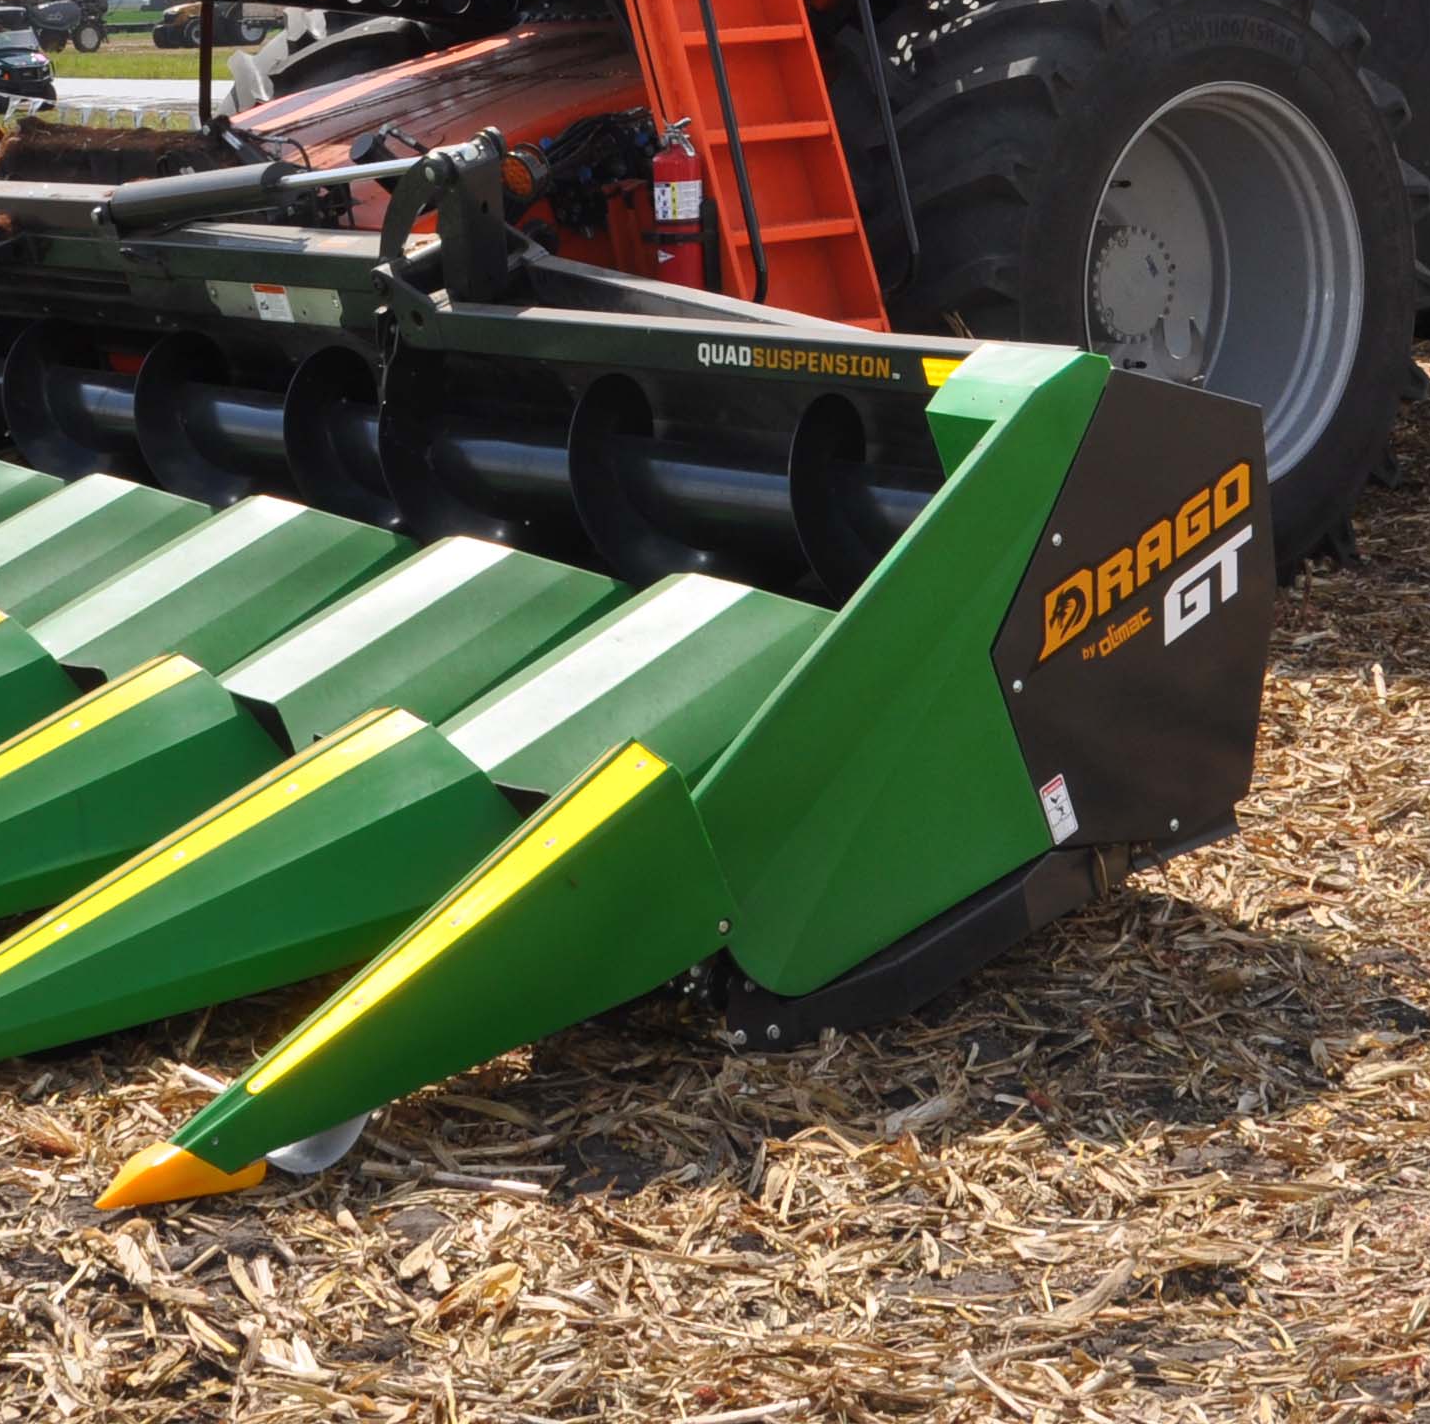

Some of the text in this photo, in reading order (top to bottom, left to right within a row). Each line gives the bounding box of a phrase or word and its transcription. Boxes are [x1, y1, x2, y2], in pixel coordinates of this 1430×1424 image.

[1038, 461, 1252, 662] DRAGO
[1164, 523, 1254, 647] GT
[1082, 641, 1096, 661] by
